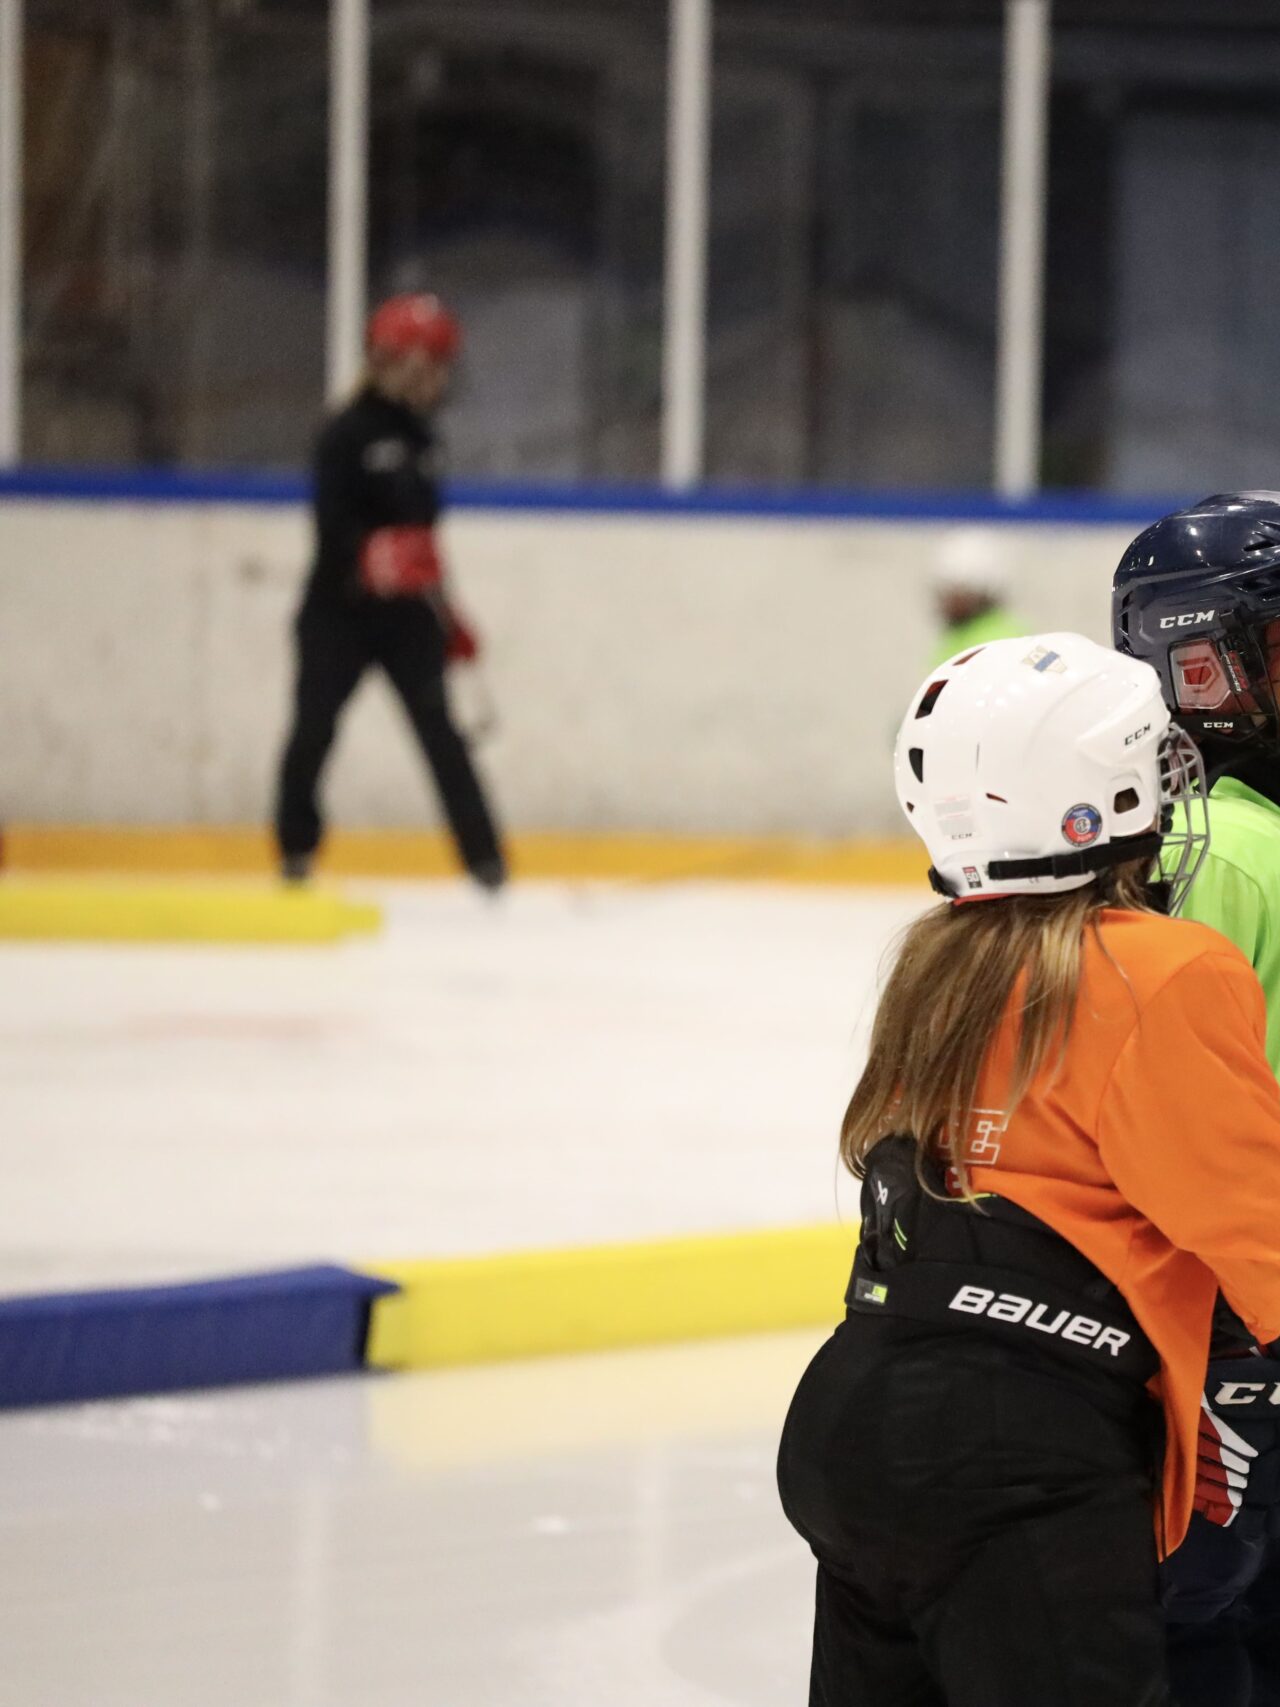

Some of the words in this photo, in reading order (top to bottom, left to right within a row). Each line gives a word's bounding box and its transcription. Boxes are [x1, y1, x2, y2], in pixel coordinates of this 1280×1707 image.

[1159, 609, 1215, 629] CCM
[1124, 723, 1151, 746] CCM
[1203, 721, 1234, 729] CCM
